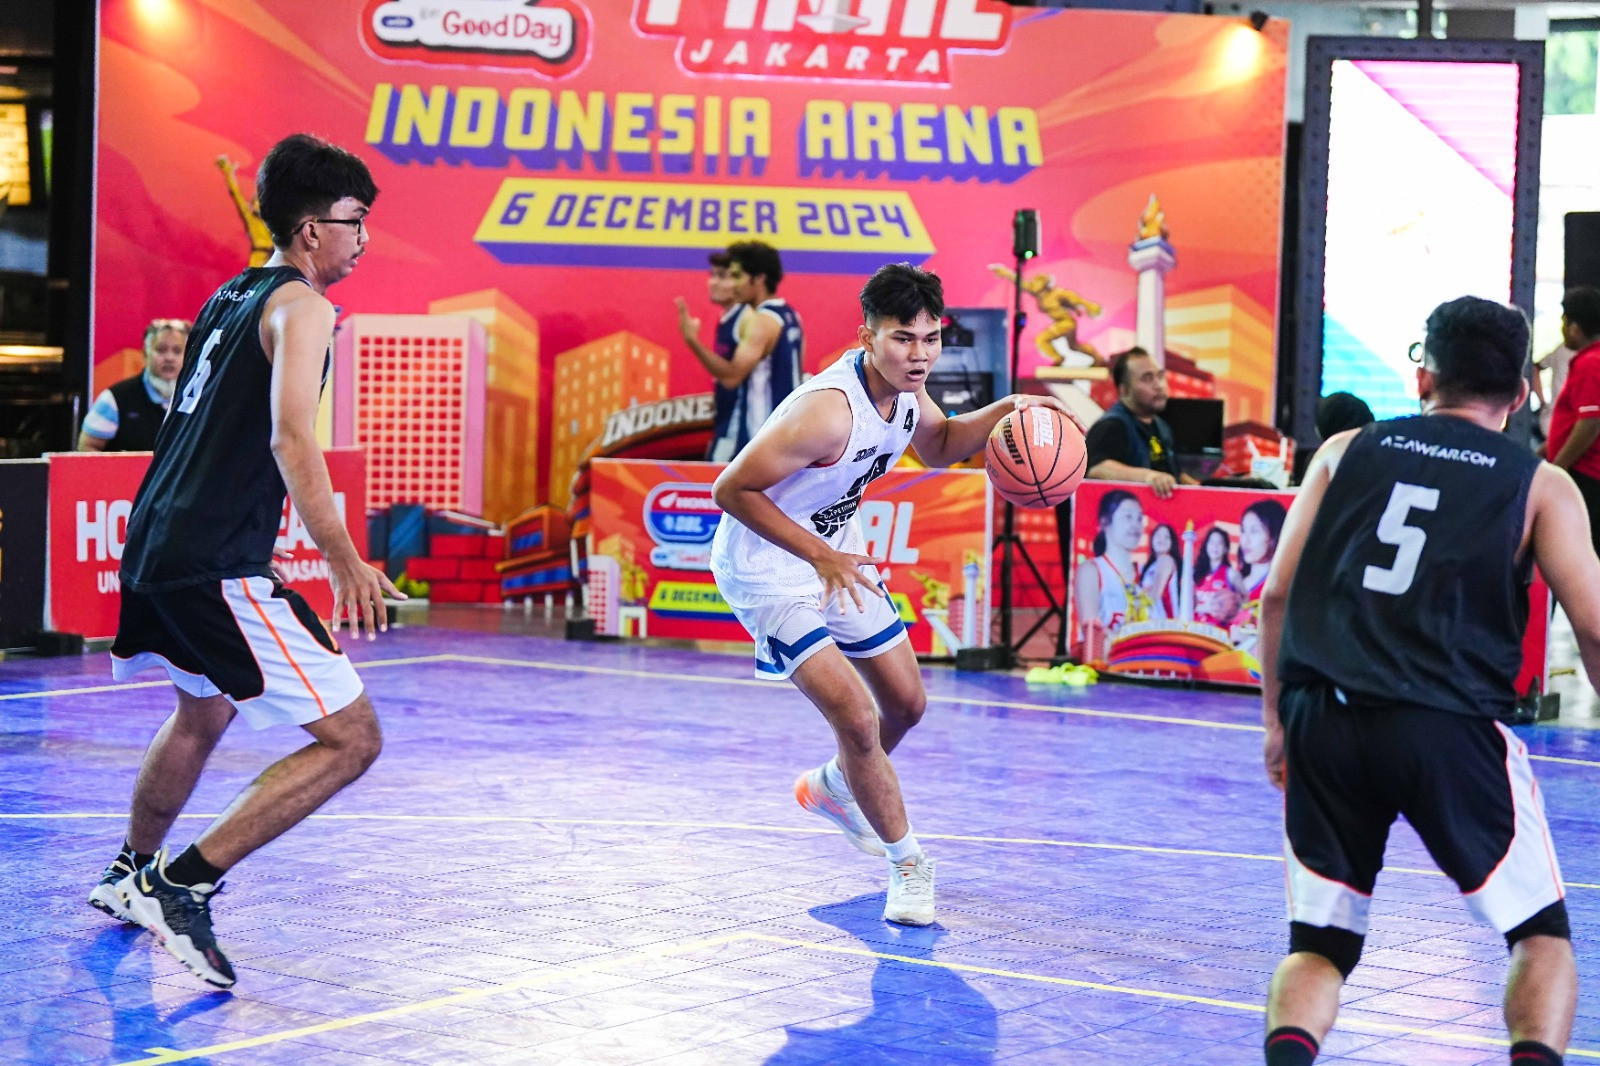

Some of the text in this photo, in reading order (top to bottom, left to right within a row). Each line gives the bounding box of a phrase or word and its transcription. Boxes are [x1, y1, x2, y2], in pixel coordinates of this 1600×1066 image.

[689, 39, 941, 74] JAKARTA
[364, 82, 1044, 167] INDONESIA ARENA
[499, 193, 912, 239] 6 DECEMBER 2024
[601, 396, 716, 449] INDONE
[76, 499, 133, 562] HO
[1363, 481, 1440, 596] 5
